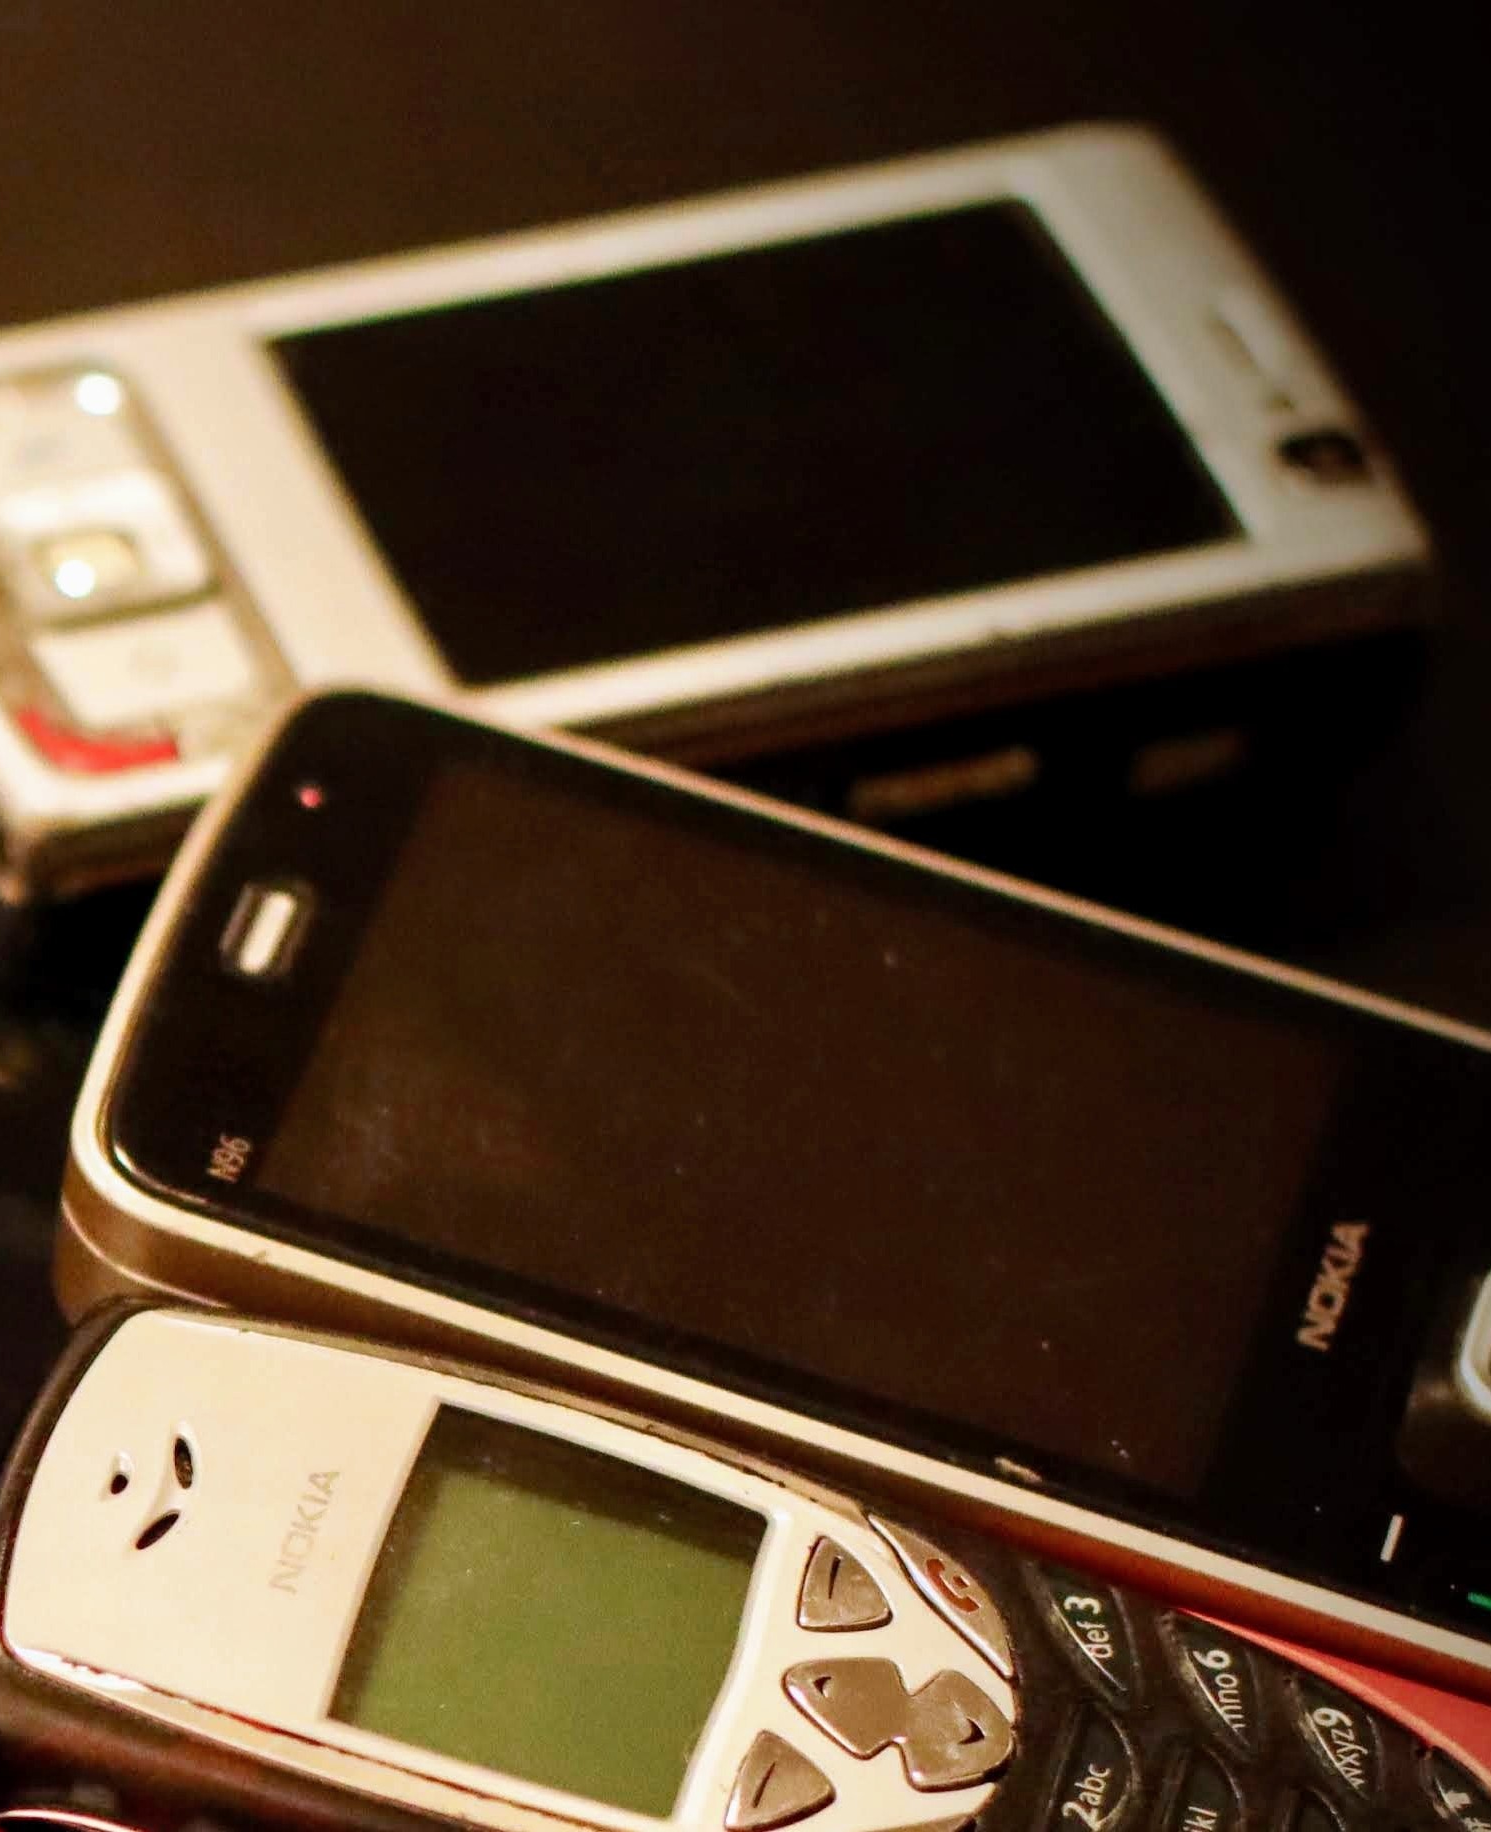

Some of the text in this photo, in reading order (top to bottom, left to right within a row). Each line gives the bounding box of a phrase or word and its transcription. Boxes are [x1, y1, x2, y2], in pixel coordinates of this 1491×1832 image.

[1295, 1219, 1372, 1353] NOKIA
[269, 1468, 341, 1595] NOKIA
[1063, 1594, 1102, 1616] 3
[1191, 1648, 1232, 1671] 6
